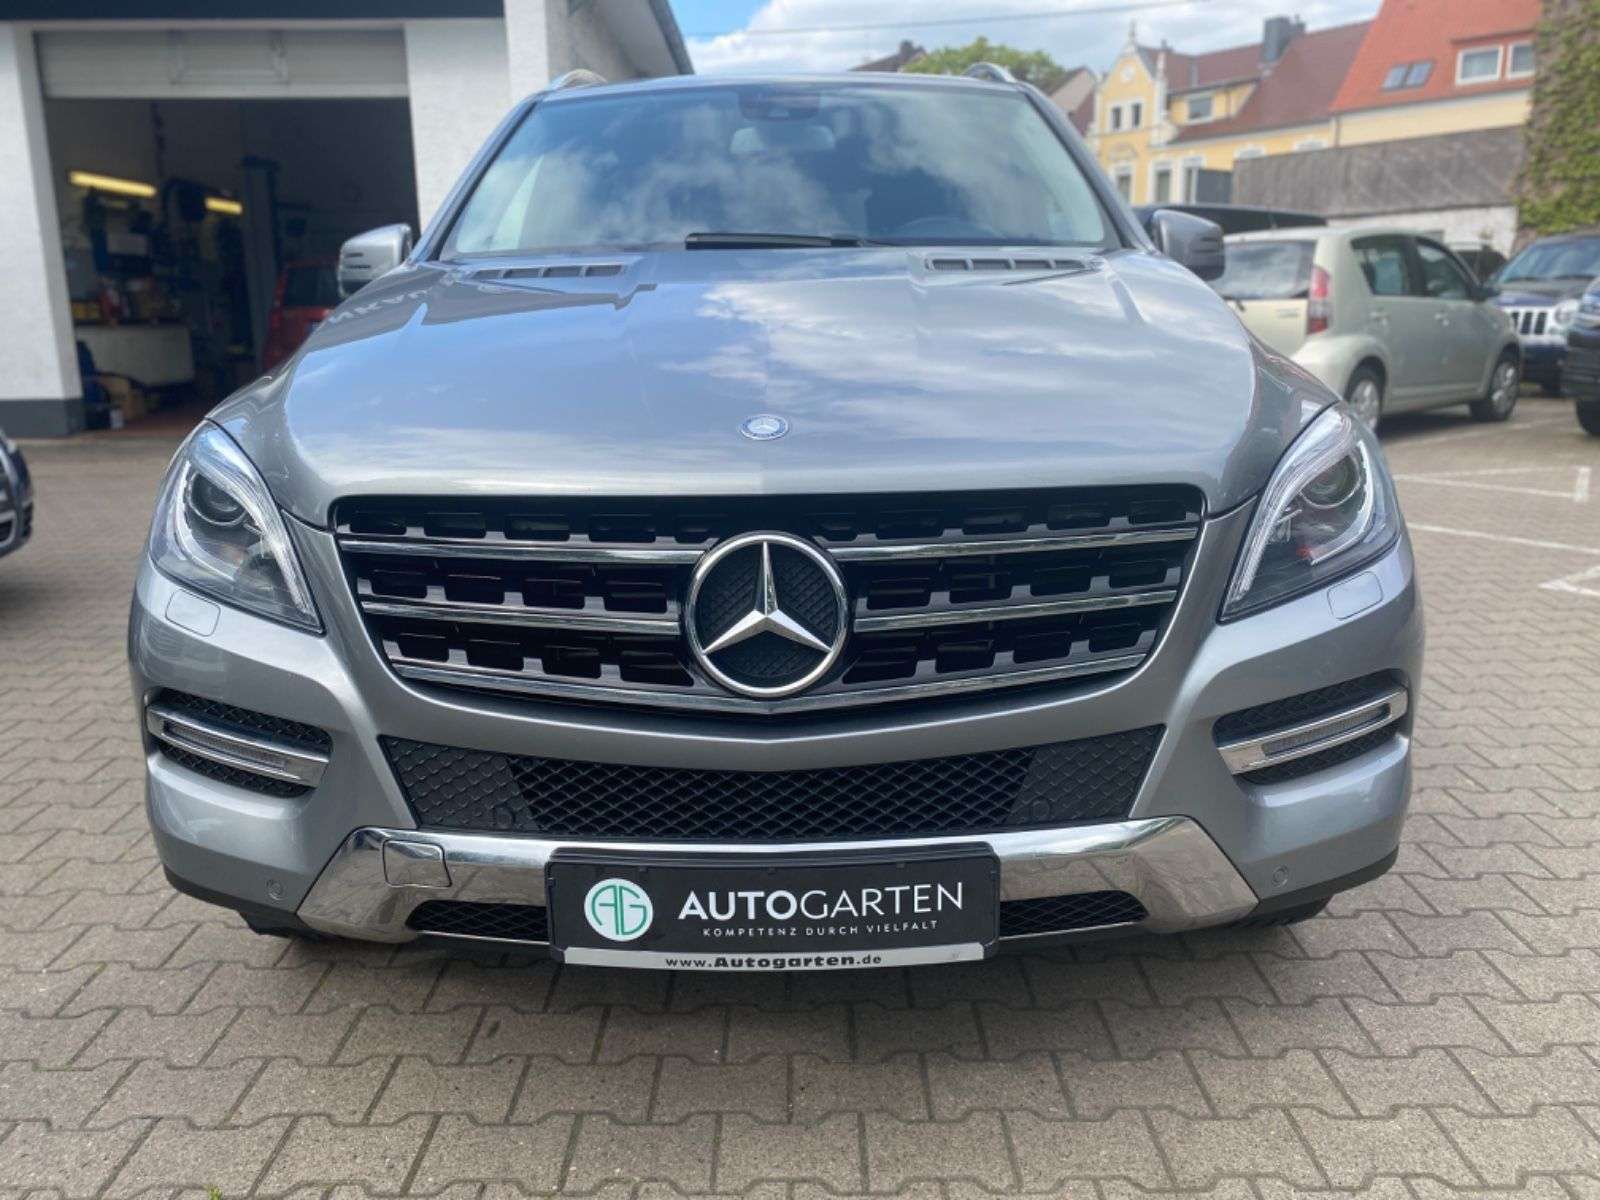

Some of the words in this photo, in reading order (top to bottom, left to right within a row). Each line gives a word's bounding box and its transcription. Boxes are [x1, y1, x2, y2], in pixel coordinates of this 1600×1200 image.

[678, 882, 963, 921] AUTOGARTEN
[702, 927, 797, 937] KOMPETENZ
[805, 926, 858, 936] DURCH
[866, 920, 938, 933] VIELFALT
[665, 953, 882, 970] www.Autogarten.de
